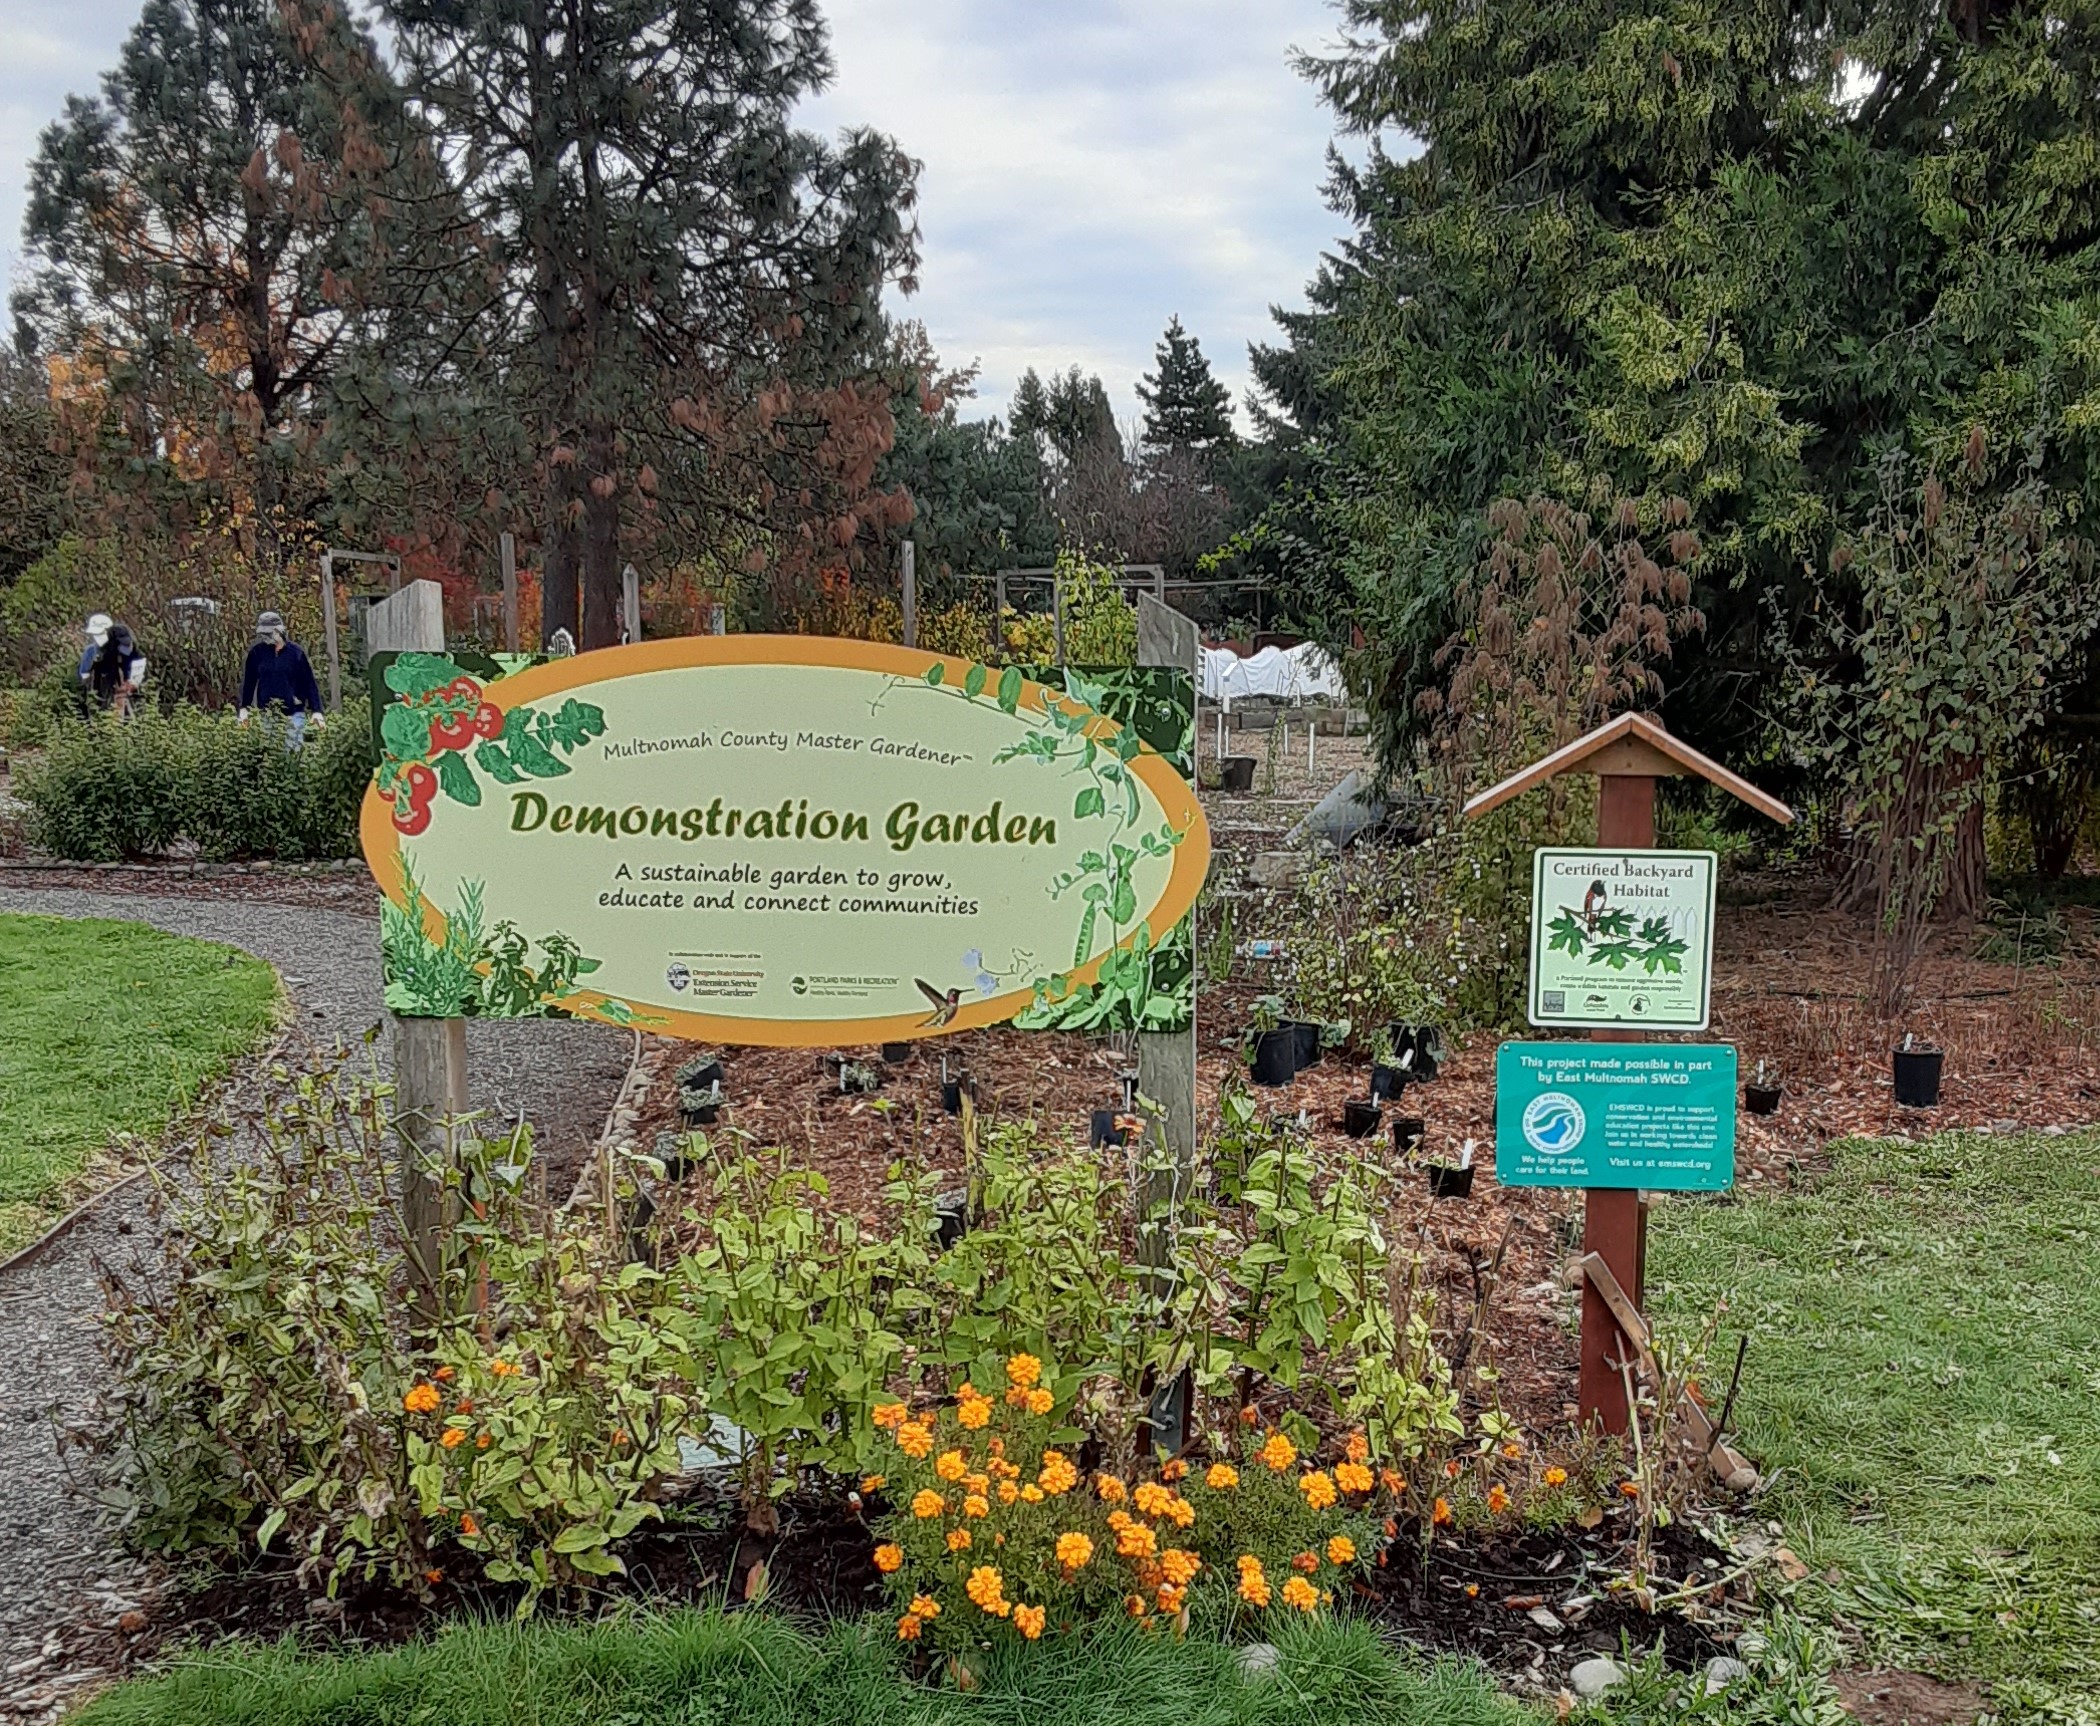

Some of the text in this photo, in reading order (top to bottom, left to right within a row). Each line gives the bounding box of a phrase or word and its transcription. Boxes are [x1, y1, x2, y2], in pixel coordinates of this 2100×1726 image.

[603, 732, 712, 760] Multnomah
[720, 731, 788, 752] County
[796, 732, 864, 752] Master
[511, 791, 1056, 851] Demonstration Garden
[614, 863, 952, 892] A sustainable garden to grow,
[1553, 862, 1694, 881] Certified Backyard
[1613, 884, 1670, 898] Habitat
[598, 888, 979, 915] educate and connect communities
[693, 979, 758, 987] Extension Service
[1519, 1056, 1543, 1067] This
[1547, 1058, 1586, 1070] project
[1590, 1058, 1621, 1069] made
[1625, 1058, 1670, 1071] possible
[1688, 1060, 1712, 1071] part
[1537, 1071, 1692, 1084] by East Multnomah SWCD.
[1654, 1104, 1676, 1113] proud
[1521, 1155, 1585, 1166] We help people
[1608, 1157, 1712, 1171] Visit us at emswcd.org
[1535, 1166, 1547, 1174] for
